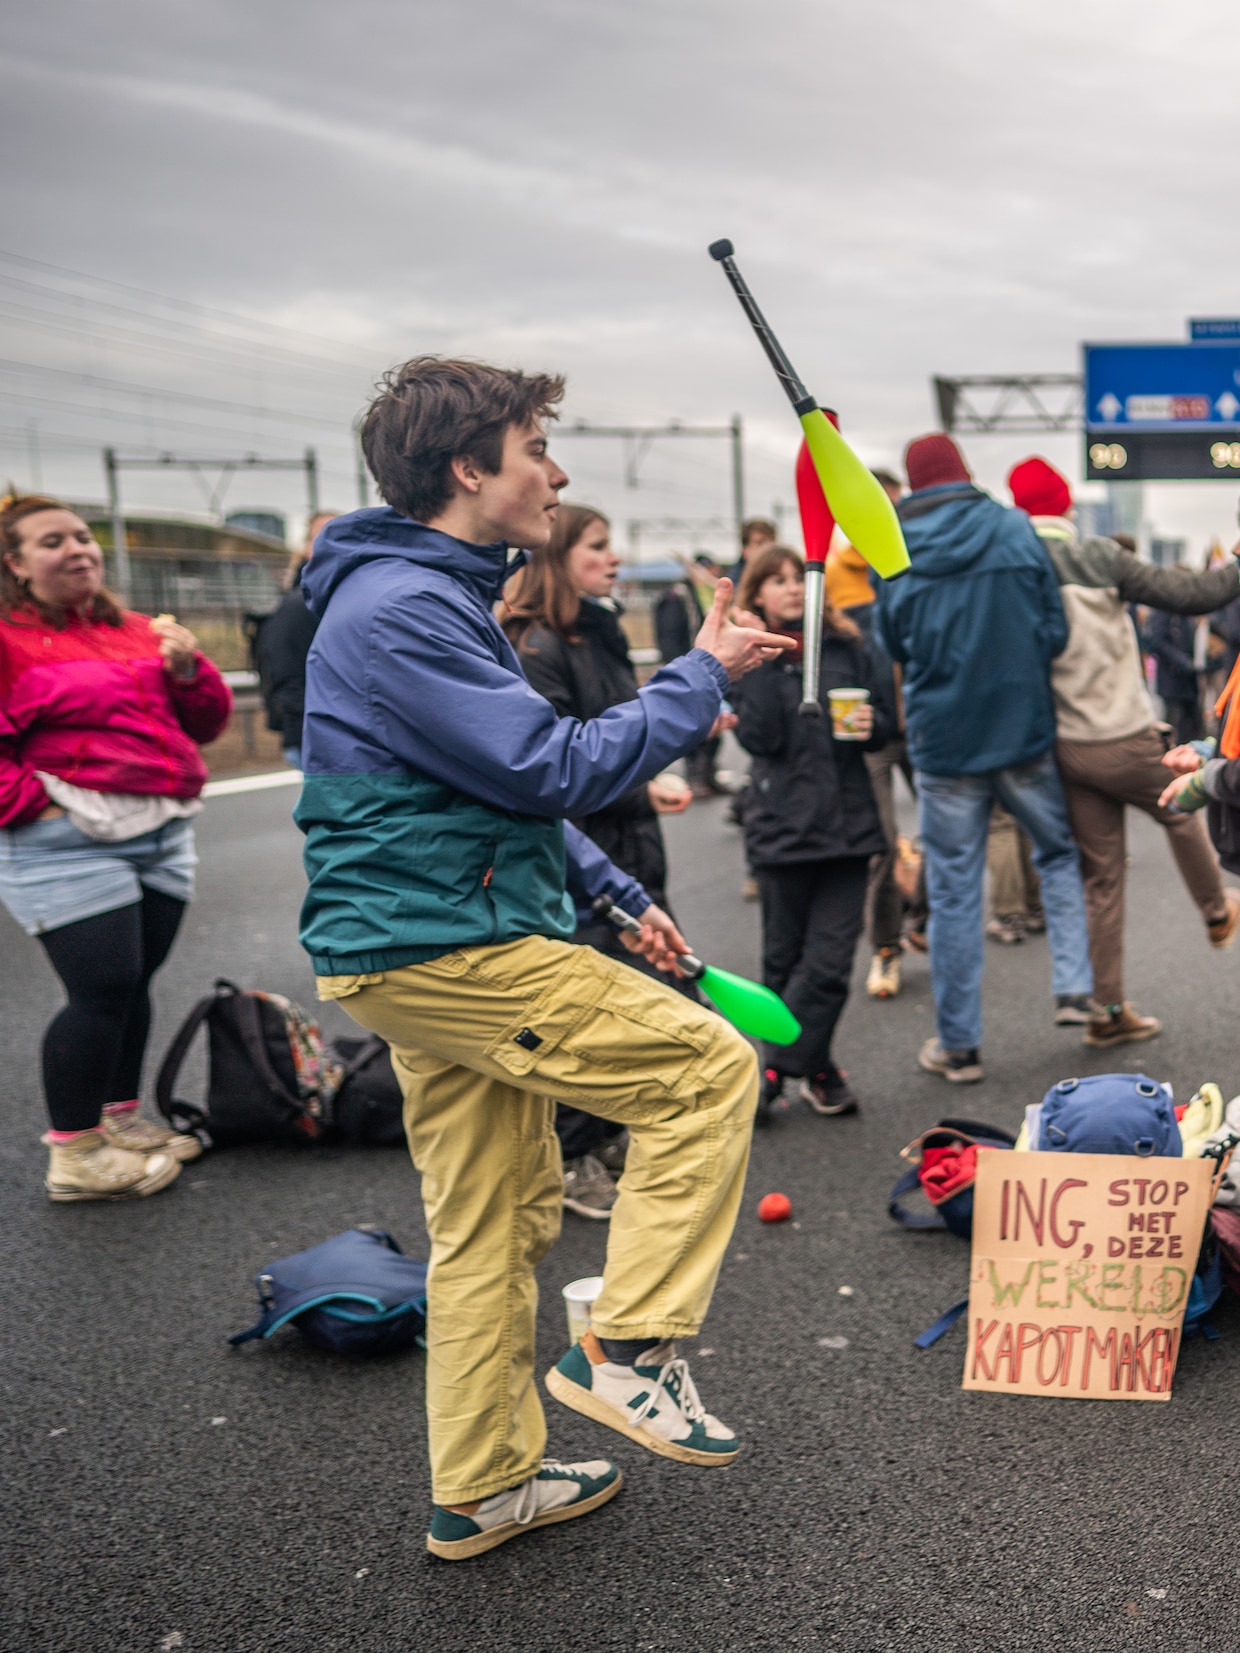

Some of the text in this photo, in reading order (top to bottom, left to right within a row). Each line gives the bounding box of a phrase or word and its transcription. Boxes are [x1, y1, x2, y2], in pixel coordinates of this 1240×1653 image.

[1108, 1179, 1189, 1207] STOP
[999, 1178, 1093, 1259] ING,
[1128, 1212, 1176, 1234] MET
[1108, 1235, 1183, 1259] DEZE
[986, 1258, 1188, 1315] WERELD
